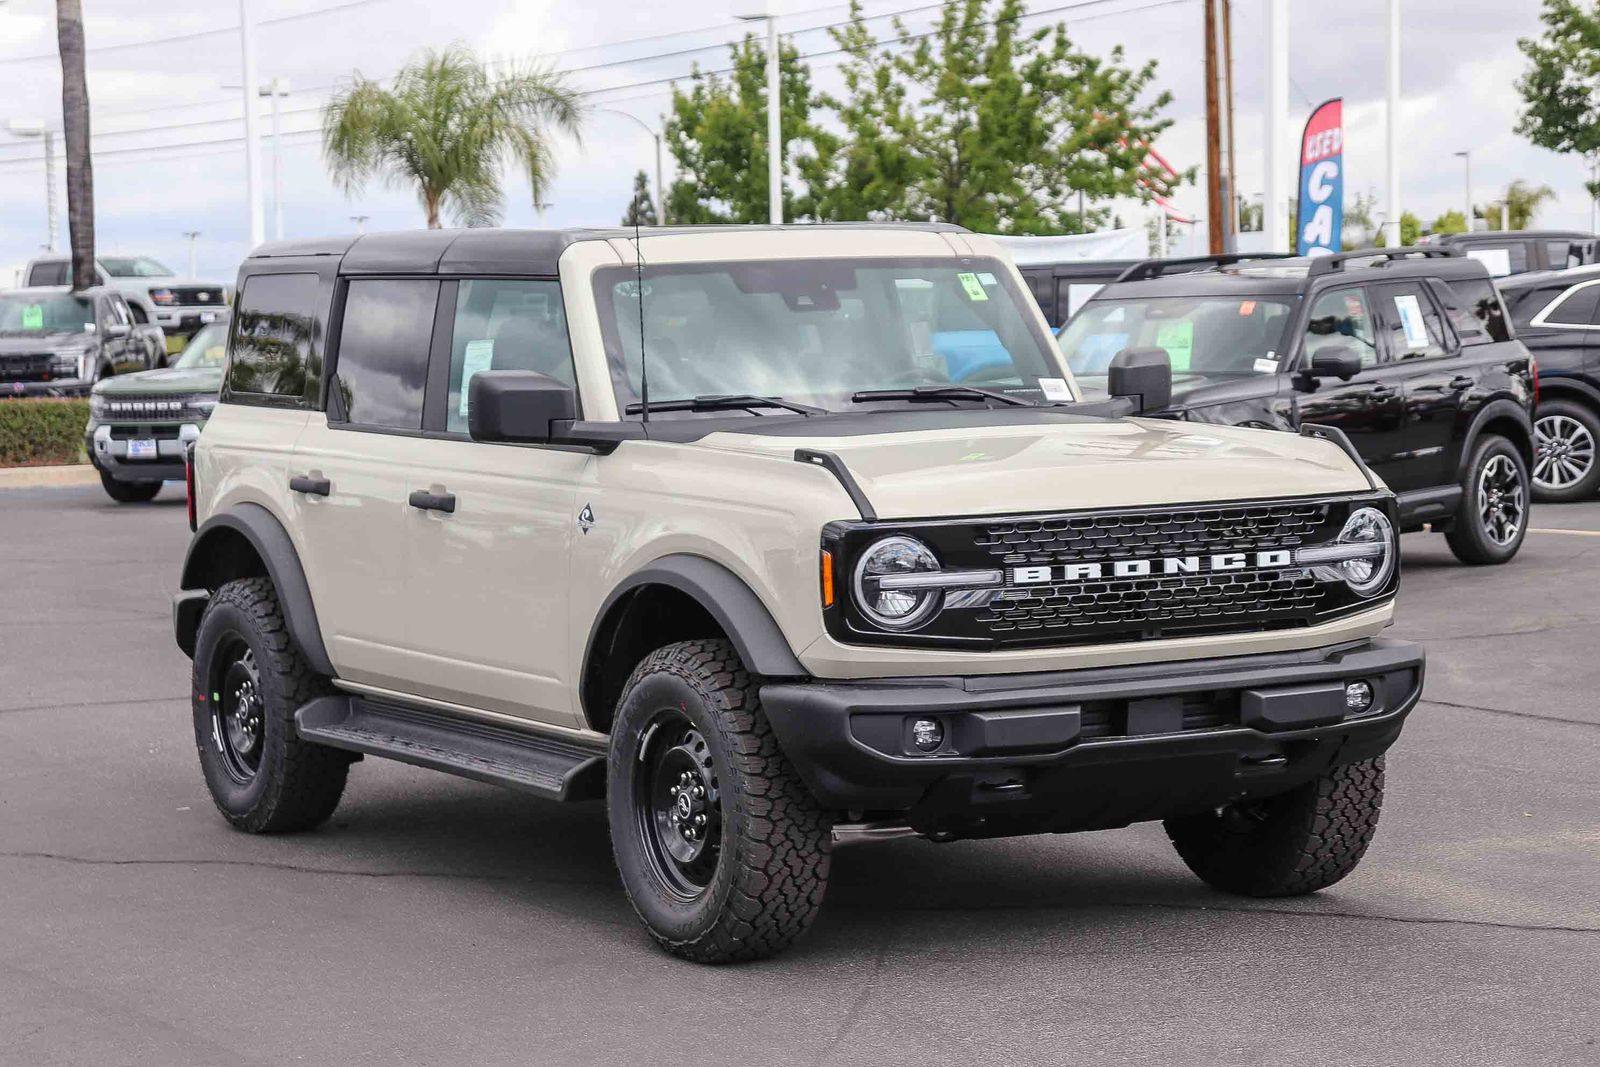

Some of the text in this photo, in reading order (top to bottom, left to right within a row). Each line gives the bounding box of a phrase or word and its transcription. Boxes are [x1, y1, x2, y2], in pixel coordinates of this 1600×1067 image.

[1303, 160, 1339, 257] CA
[111, 402, 181, 411] BRONCO
[1013, 549, 1291, 584] BRONCO
